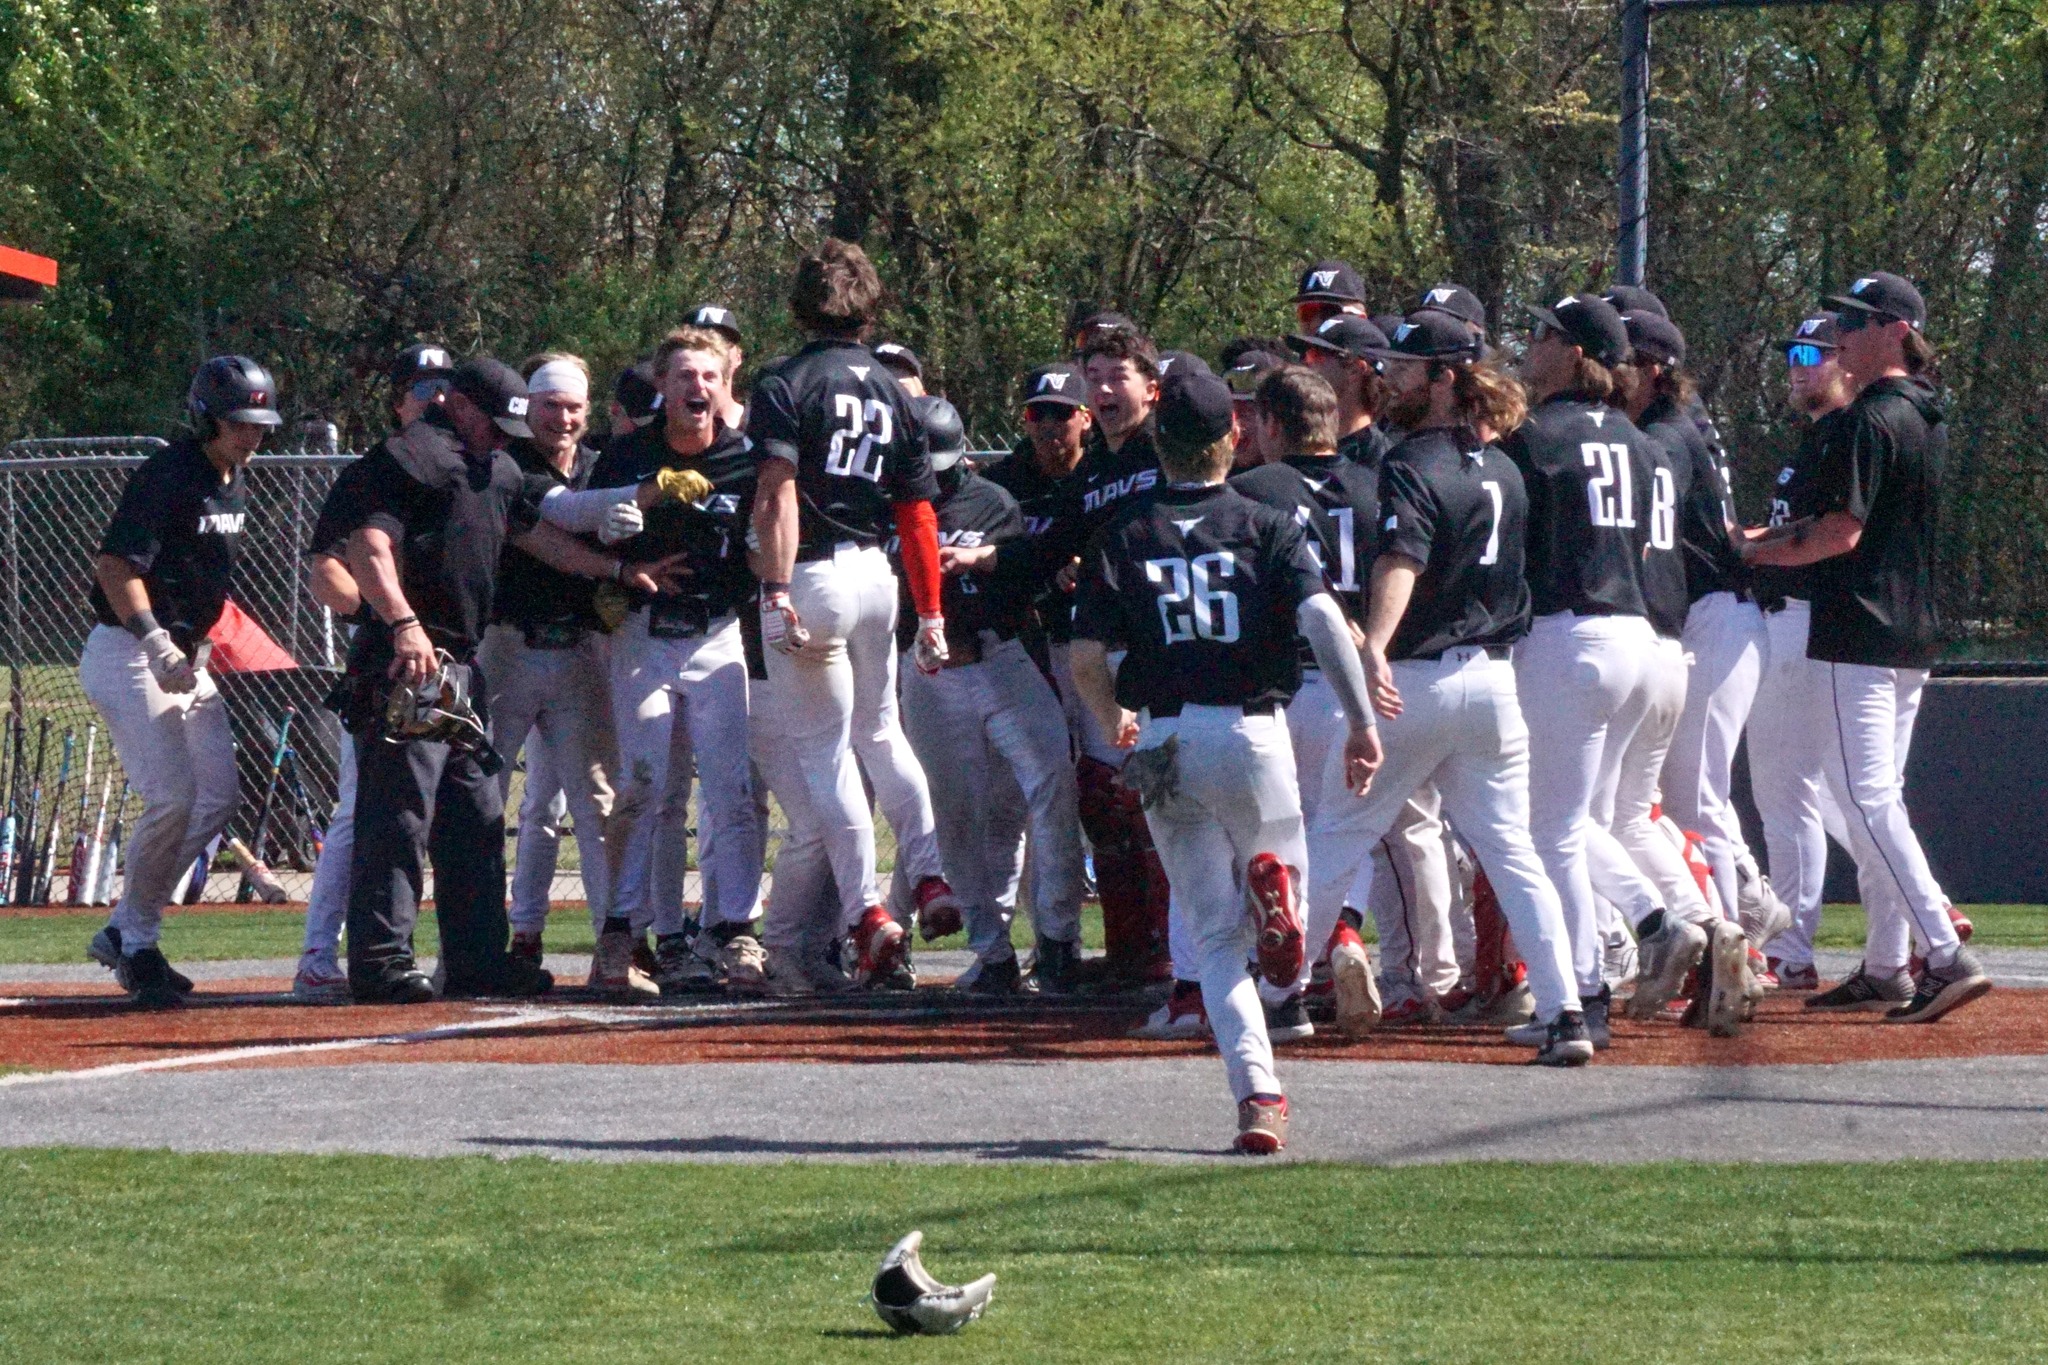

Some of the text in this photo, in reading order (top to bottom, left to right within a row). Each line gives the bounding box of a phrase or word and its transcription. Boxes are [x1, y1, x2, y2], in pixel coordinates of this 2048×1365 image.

[825, 393, 893, 483] 22
[1083, 468, 1159, 514] MAVS
[1479, 481, 1503, 566] 1
[1581, 442, 1636, 529] 21
[1145, 551, 1241, 646] 26
